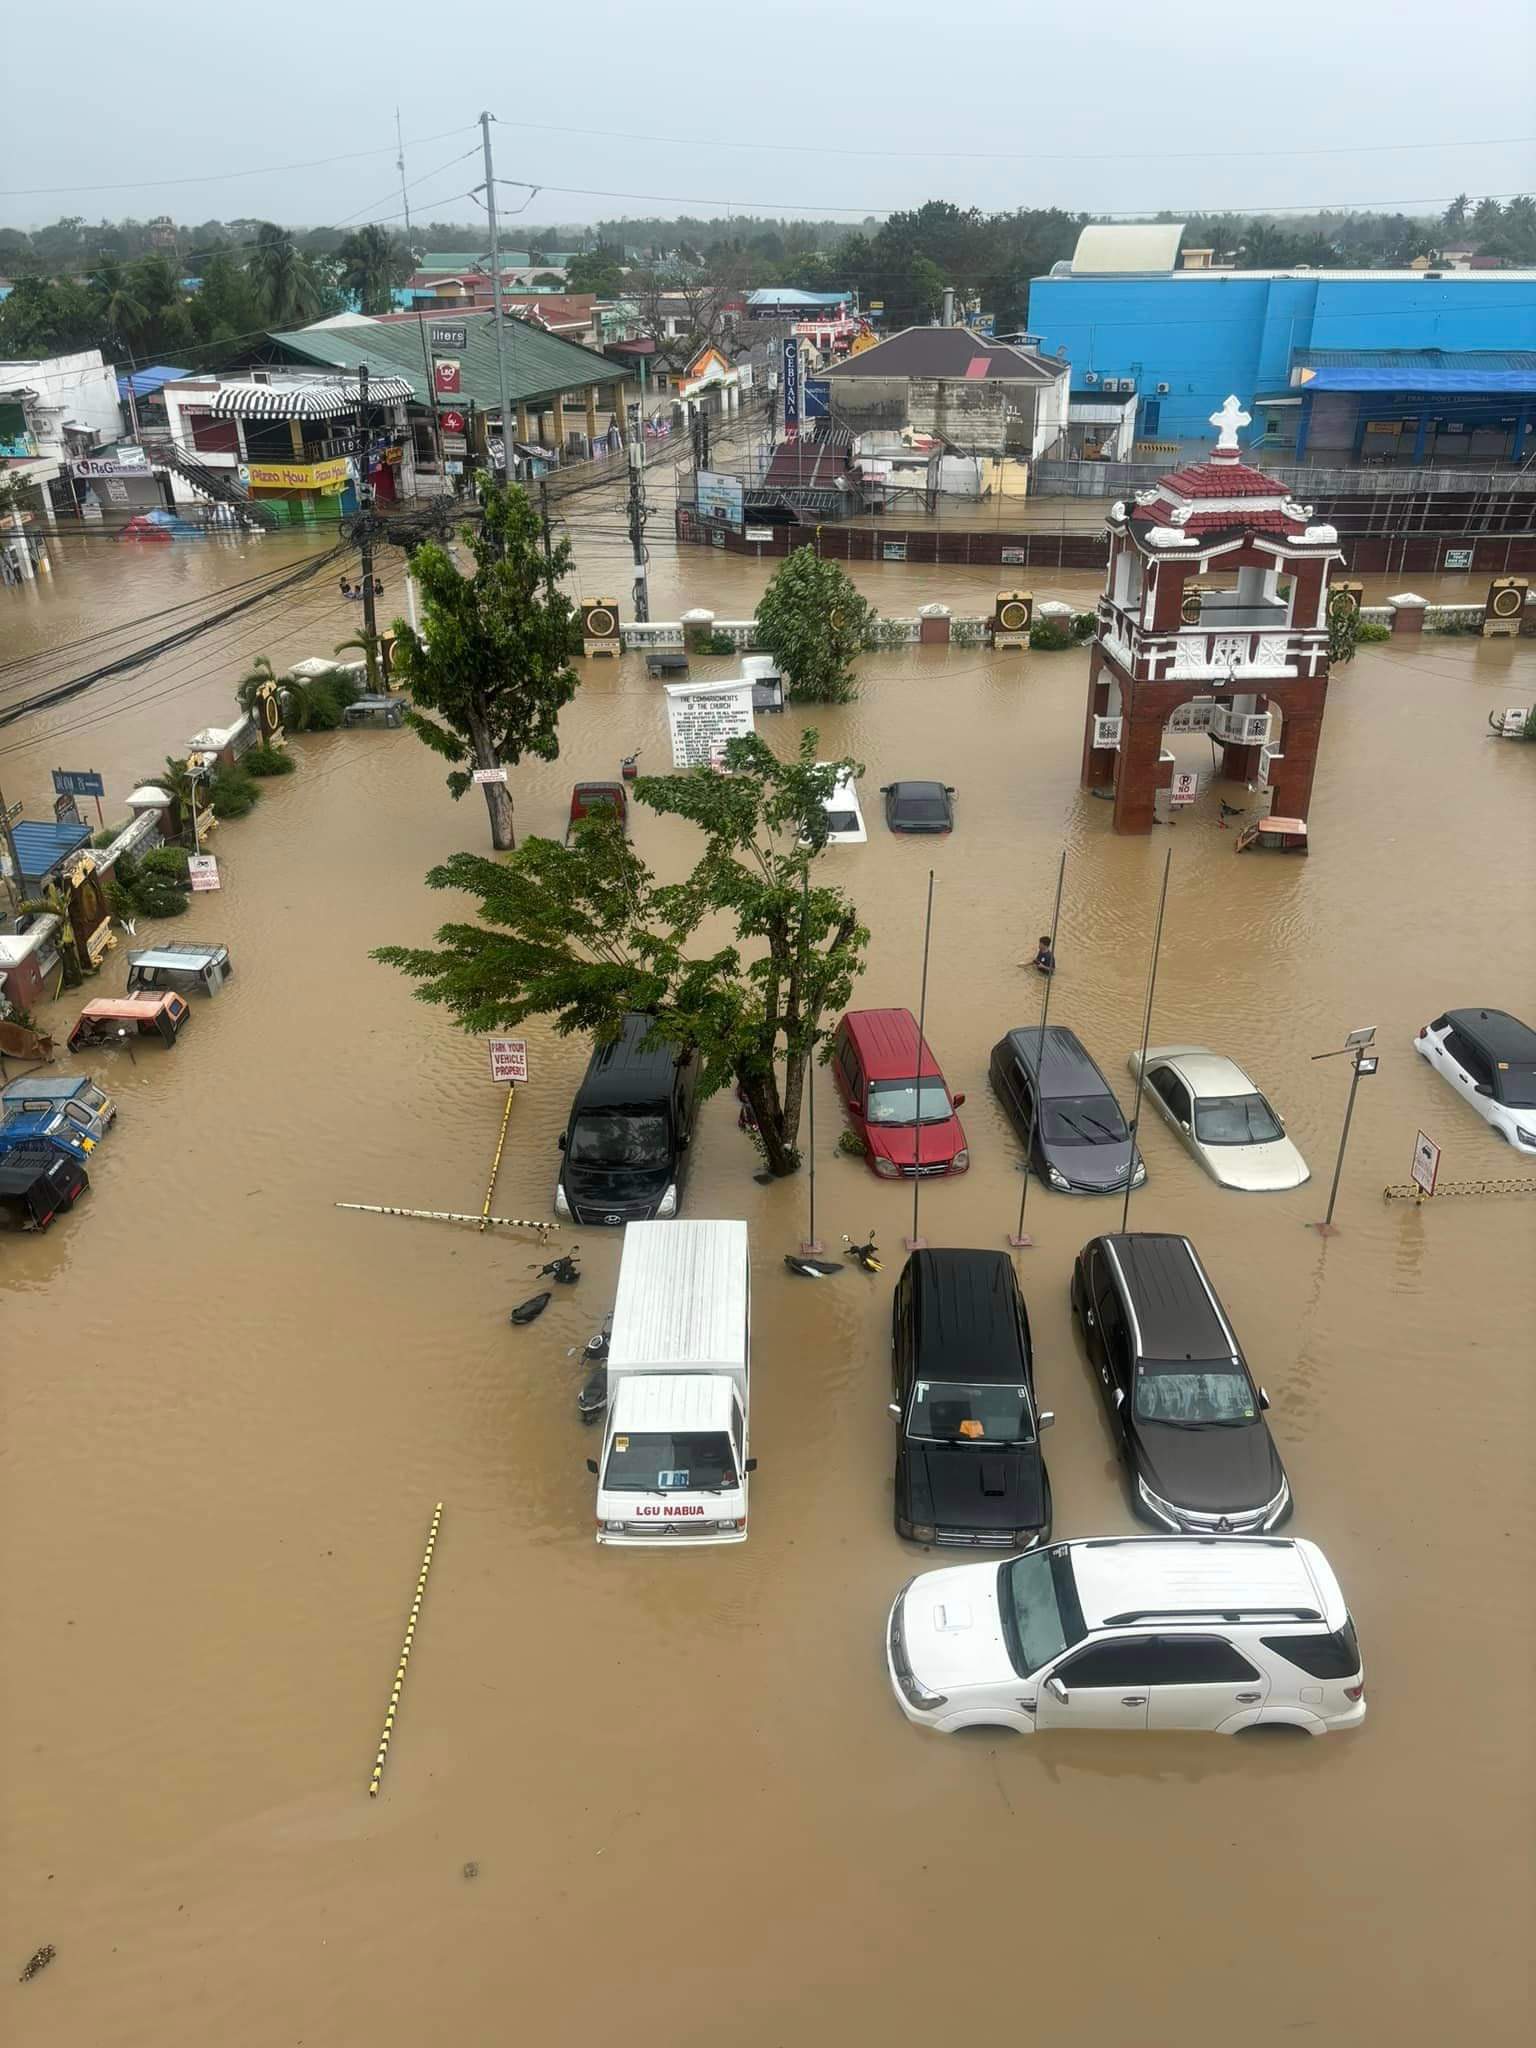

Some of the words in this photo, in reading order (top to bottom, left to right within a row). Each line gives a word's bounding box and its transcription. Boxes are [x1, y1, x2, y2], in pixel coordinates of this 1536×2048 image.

[785, 343, 796, 415] CEBUANA
[680, 695, 691, 703] THE
[709, 702, 731, 710] CHURCH
[491, 1042, 507, 1052] PARK
[508, 1042, 524, 1053] YOUR
[494, 1054, 525, 1065] VEHICLE
[636, 1506, 661, 1516] LGU
[663, 1505, 705, 1516] NABUA
